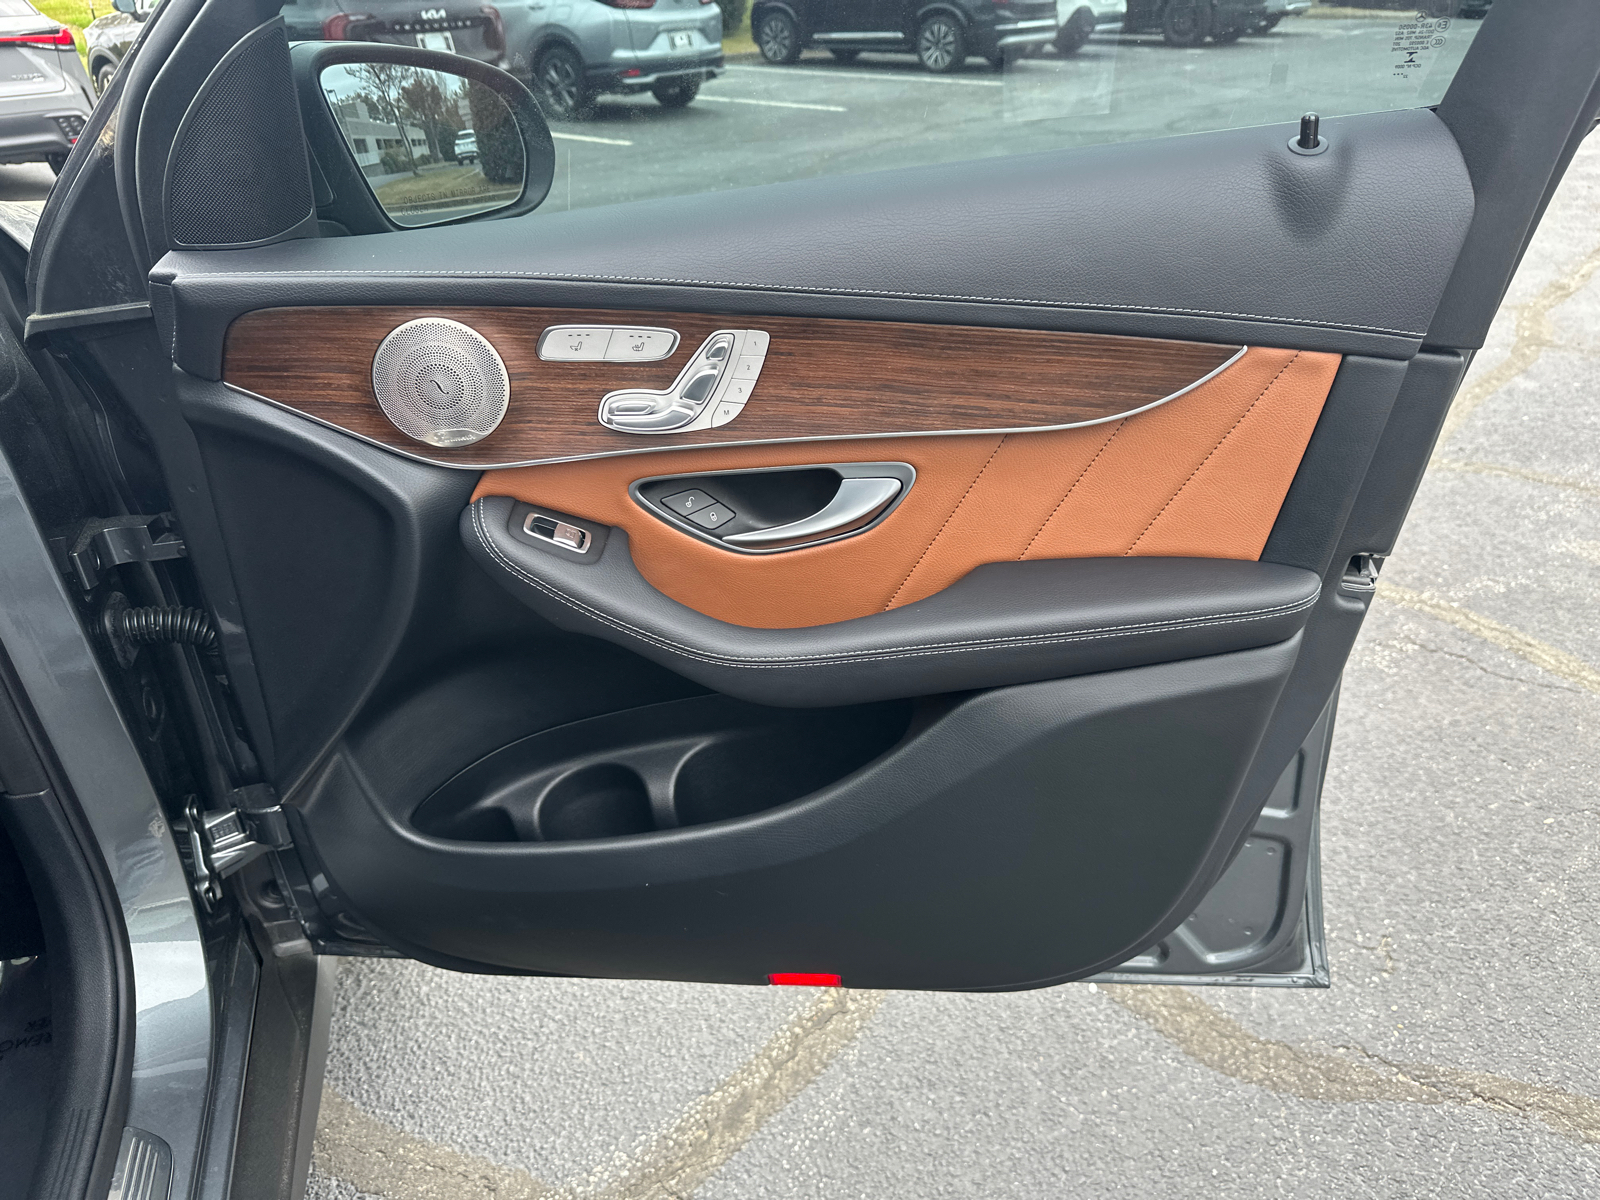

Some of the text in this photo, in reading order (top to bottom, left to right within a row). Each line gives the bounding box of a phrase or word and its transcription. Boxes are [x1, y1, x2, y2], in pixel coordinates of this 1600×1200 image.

[403, 184, 491, 205] OBJECTS IN MIRROR ARE
